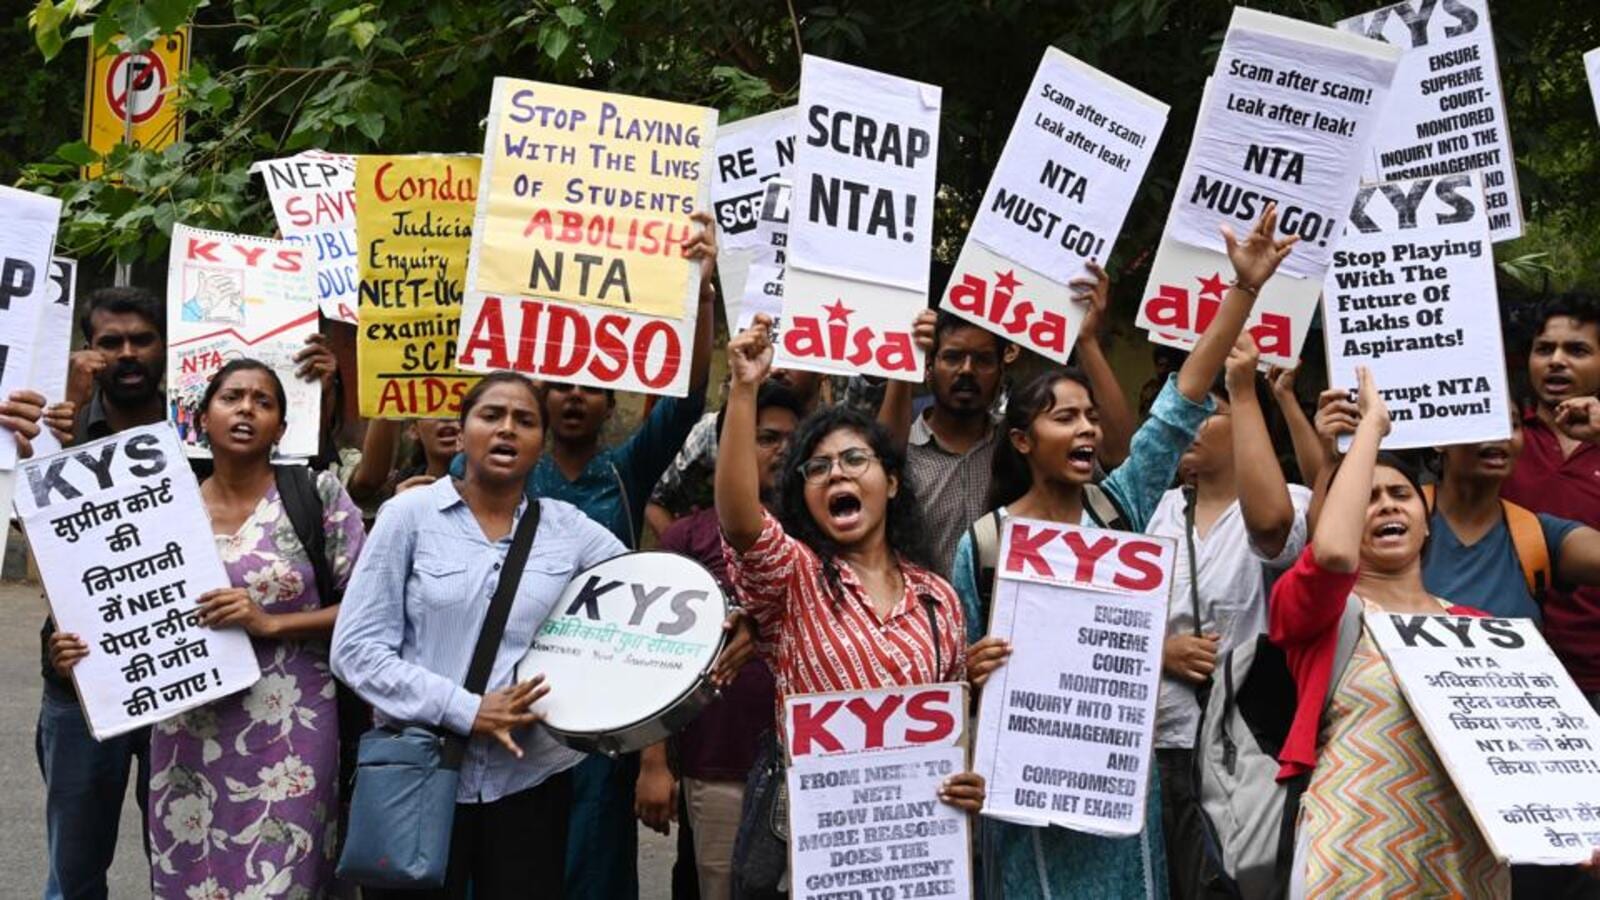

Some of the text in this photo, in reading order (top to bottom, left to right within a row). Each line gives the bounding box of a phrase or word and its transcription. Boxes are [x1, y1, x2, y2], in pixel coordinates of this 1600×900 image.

[1351, 0, 1479, 49] KYS
[1428, 44, 1481, 73] ENSURE
[1228, 58, 1373, 106] Scam after scam!
[1420, 66, 1484, 96] SUPREME
[1041, 83, 1147, 149] Scam after scam!
[1226, 92, 1357, 138] Leak after leak!
[1439, 87, 1491, 113] COURT-
[806, 104, 930, 169] SCRAP
[1416, 107, 1495, 140] MONITORED
[1034, 112, 1131, 173] Leak after leak!
[1380, 127, 1499, 168] INQUIRY INTO THE
[268, 162, 339, 190] NEP
[718, 147, 757, 183] RE
[1243, 143, 1306, 186] NTA
[1039, 159, 1089, 205] NTA
[808, 172, 917, 243] NTA!
[523, 208, 690, 258] ABOLISH
[991, 188, 1106, 263] MUST GO!
[1279, 205, 1336, 248] GO!
[187, 237, 303, 272] KYS
[370, 240, 448, 280] Enquiry
[1333, 239, 1483, 269] Stop Playing
[528, 248, 631, 303] NTA
[1335, 263, 1448, 290] With The
[948, 269, 1068, 354] aisa
[1337, 284, 1451, 312] Future Of
[1145, 273, 1291, 357] aia
[1340, 307, 1445, 335] Lakhs Of
[459, 296, 682, 389] AIDSO
[783, 299, 917, 372] aisa
[1342, 328, 1465, 359] Aspirants!
[181, 350, 224, 374] NTA
[1347, 376, 1492, 404] Crupt NTA
[1418, 398, 1492, 420] Down!
[25, 433, 168, 508] KYS
[51, 478, 175, 542] सुप्रीम कोर्ट
[105, 523, 141, 553] की
[82, 541, 185, 596] निगरानी
[1005, 524, 1164, 592] KYS
[98, 580, 187, 625] में NEET
[565, 575, 709, 636] KYS
[1094, 605, 1153, 629] ENSURE
[99, 624, 151, 657] पेपर
[1078, 627, 1149, 653] SUPREME
[1390, 614, 1525, 649] KYS
[121, 653, 156, 685] की
[1092, 652, 1151, 676] COURT-
[1456, 657, 1500, 668] NTA
[123, 687, 156, 719] की
[1059, 673, 1149, 700] MONITORED
[792, 690, 955, 756] KYS
[1010, 691, 1147, 726] INQUIRY INTO THE
[1449, 712, 1500, 731] किया
[1008, 715, 1143, 749] MISMANAGEMENT
[1476, 739, 1522, 752] NTA
[1555, 734, 1593, 752] भंग
[800, 768, 860, 791] FROM
[924, 759, 953, 777] TO
[1107, 752, 1139, 773] AND
[1487, 756, 1541, 775] किया
[853, 785, 902, 805] NET!
[1022, 765, 1136, 797] COMPROMISED
[817, 801, 938, 829] HOW MANY
[1015, 788, 1133, 821] UGC NET EXAM!
[799, 819, 960, 852] MORE REASONS
[830, 842, 929, 868] DOES THE
[806, 859, 954, 891] GOVERNMENT
[866, 886, 896, 900] TO
[899, 879, 956, 899] TAKE
